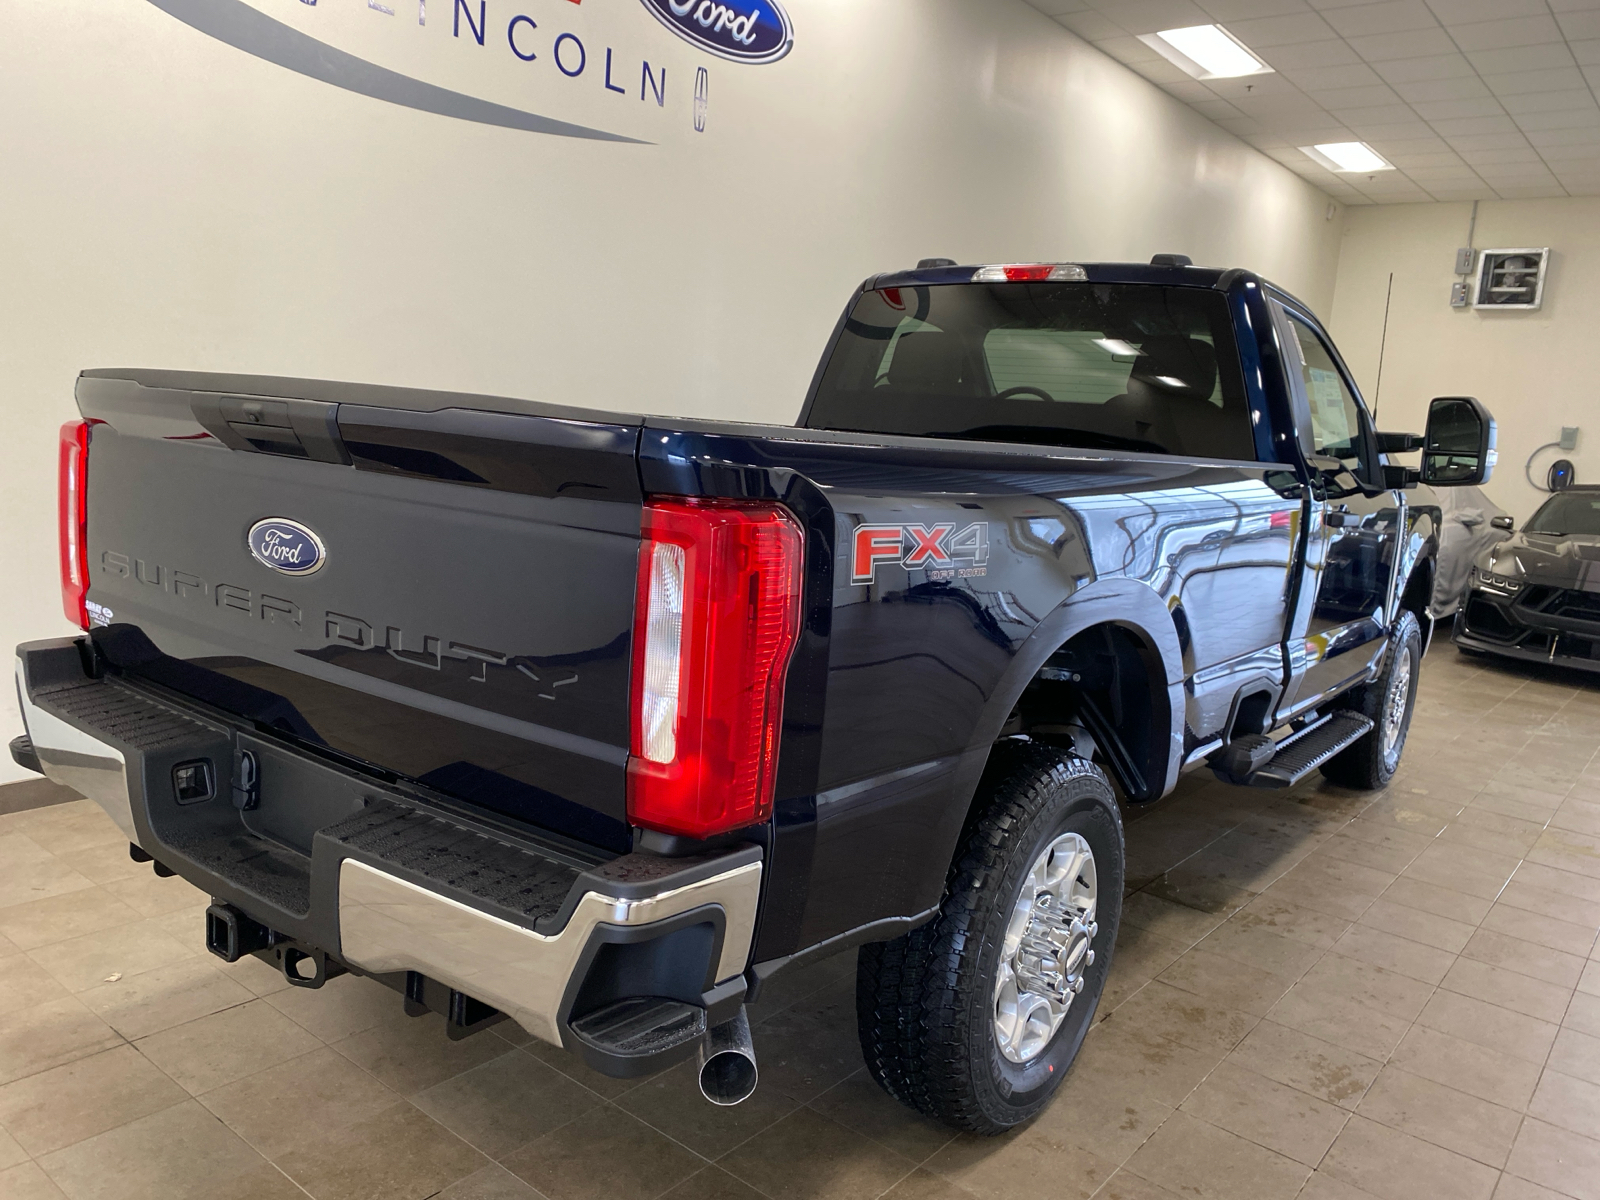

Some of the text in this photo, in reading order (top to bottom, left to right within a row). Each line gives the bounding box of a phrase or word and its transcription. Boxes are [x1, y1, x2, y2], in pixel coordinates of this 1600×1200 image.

[668, 0, 760, 46] ord
[261, 528, 303, 564] Ford
[851, 522, 990, 586] FX4
[931, 567, 987, 581] OFF ROAD
[102, 550, 579, 701] SUPER DUTY
